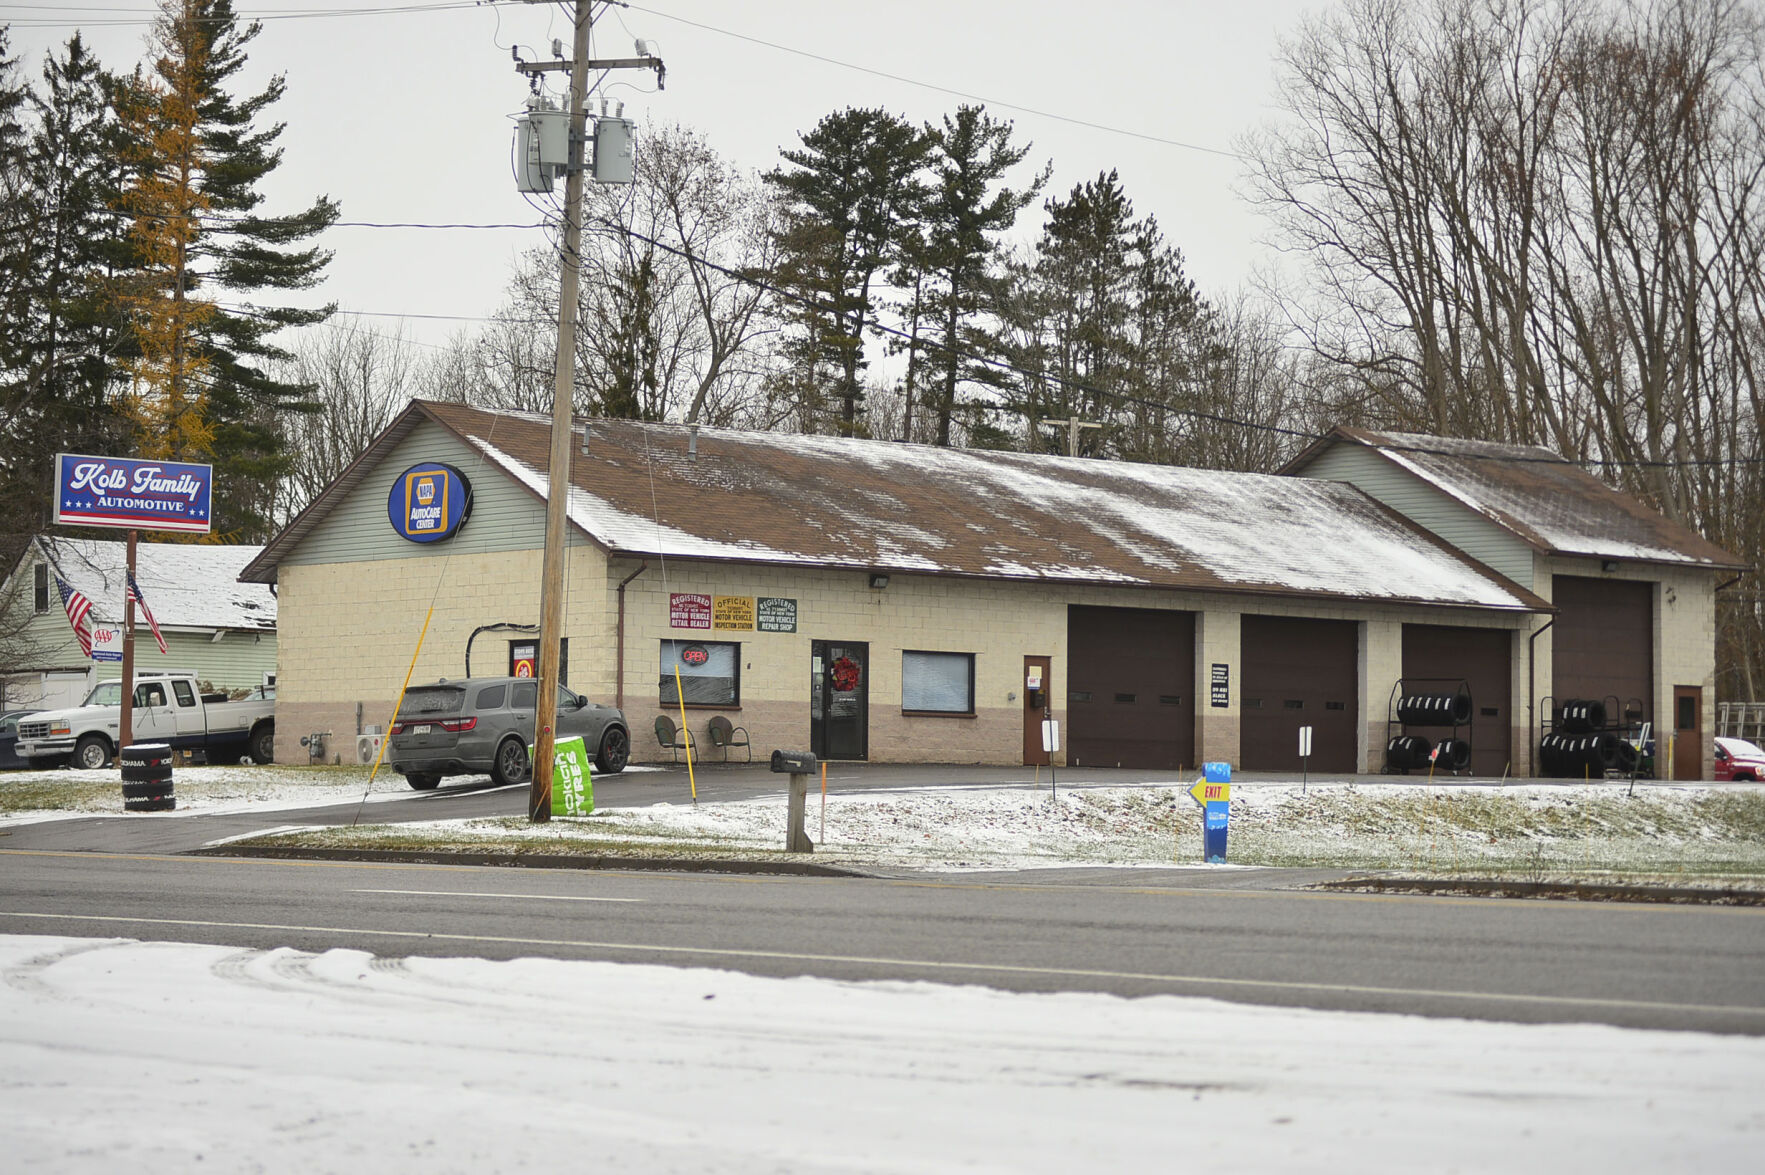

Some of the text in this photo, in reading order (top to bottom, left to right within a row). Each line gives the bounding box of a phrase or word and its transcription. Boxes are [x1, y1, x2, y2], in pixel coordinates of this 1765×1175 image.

[70, 463, 202, 501] Kolb Family
[419, 484, 433, 498] NAPA
[97, 497, 184, 512] AUTOMOTIVE
[416, 519, 435, 529] CENTER
[671, 595, 710, 607] REGISTERED
[717, 598, 752, 609] OFFICIAL
[759, 598, 796, 612] REGISTERED
[671, 611, 710, 620] MOTOR VEHICLE
[758, 615, 796, 624] MOTOR VEHICLE
[671, 619, 710, 628] RETAIL DEALER
[761, 622, 779, 630] REPAIR
[94, 629, 112, 643] AAA
[683, 650, 708, 662] OPEN
[567, 751, 586, 816] TYRES
[1204, 785, 1222, 799] EXIT
